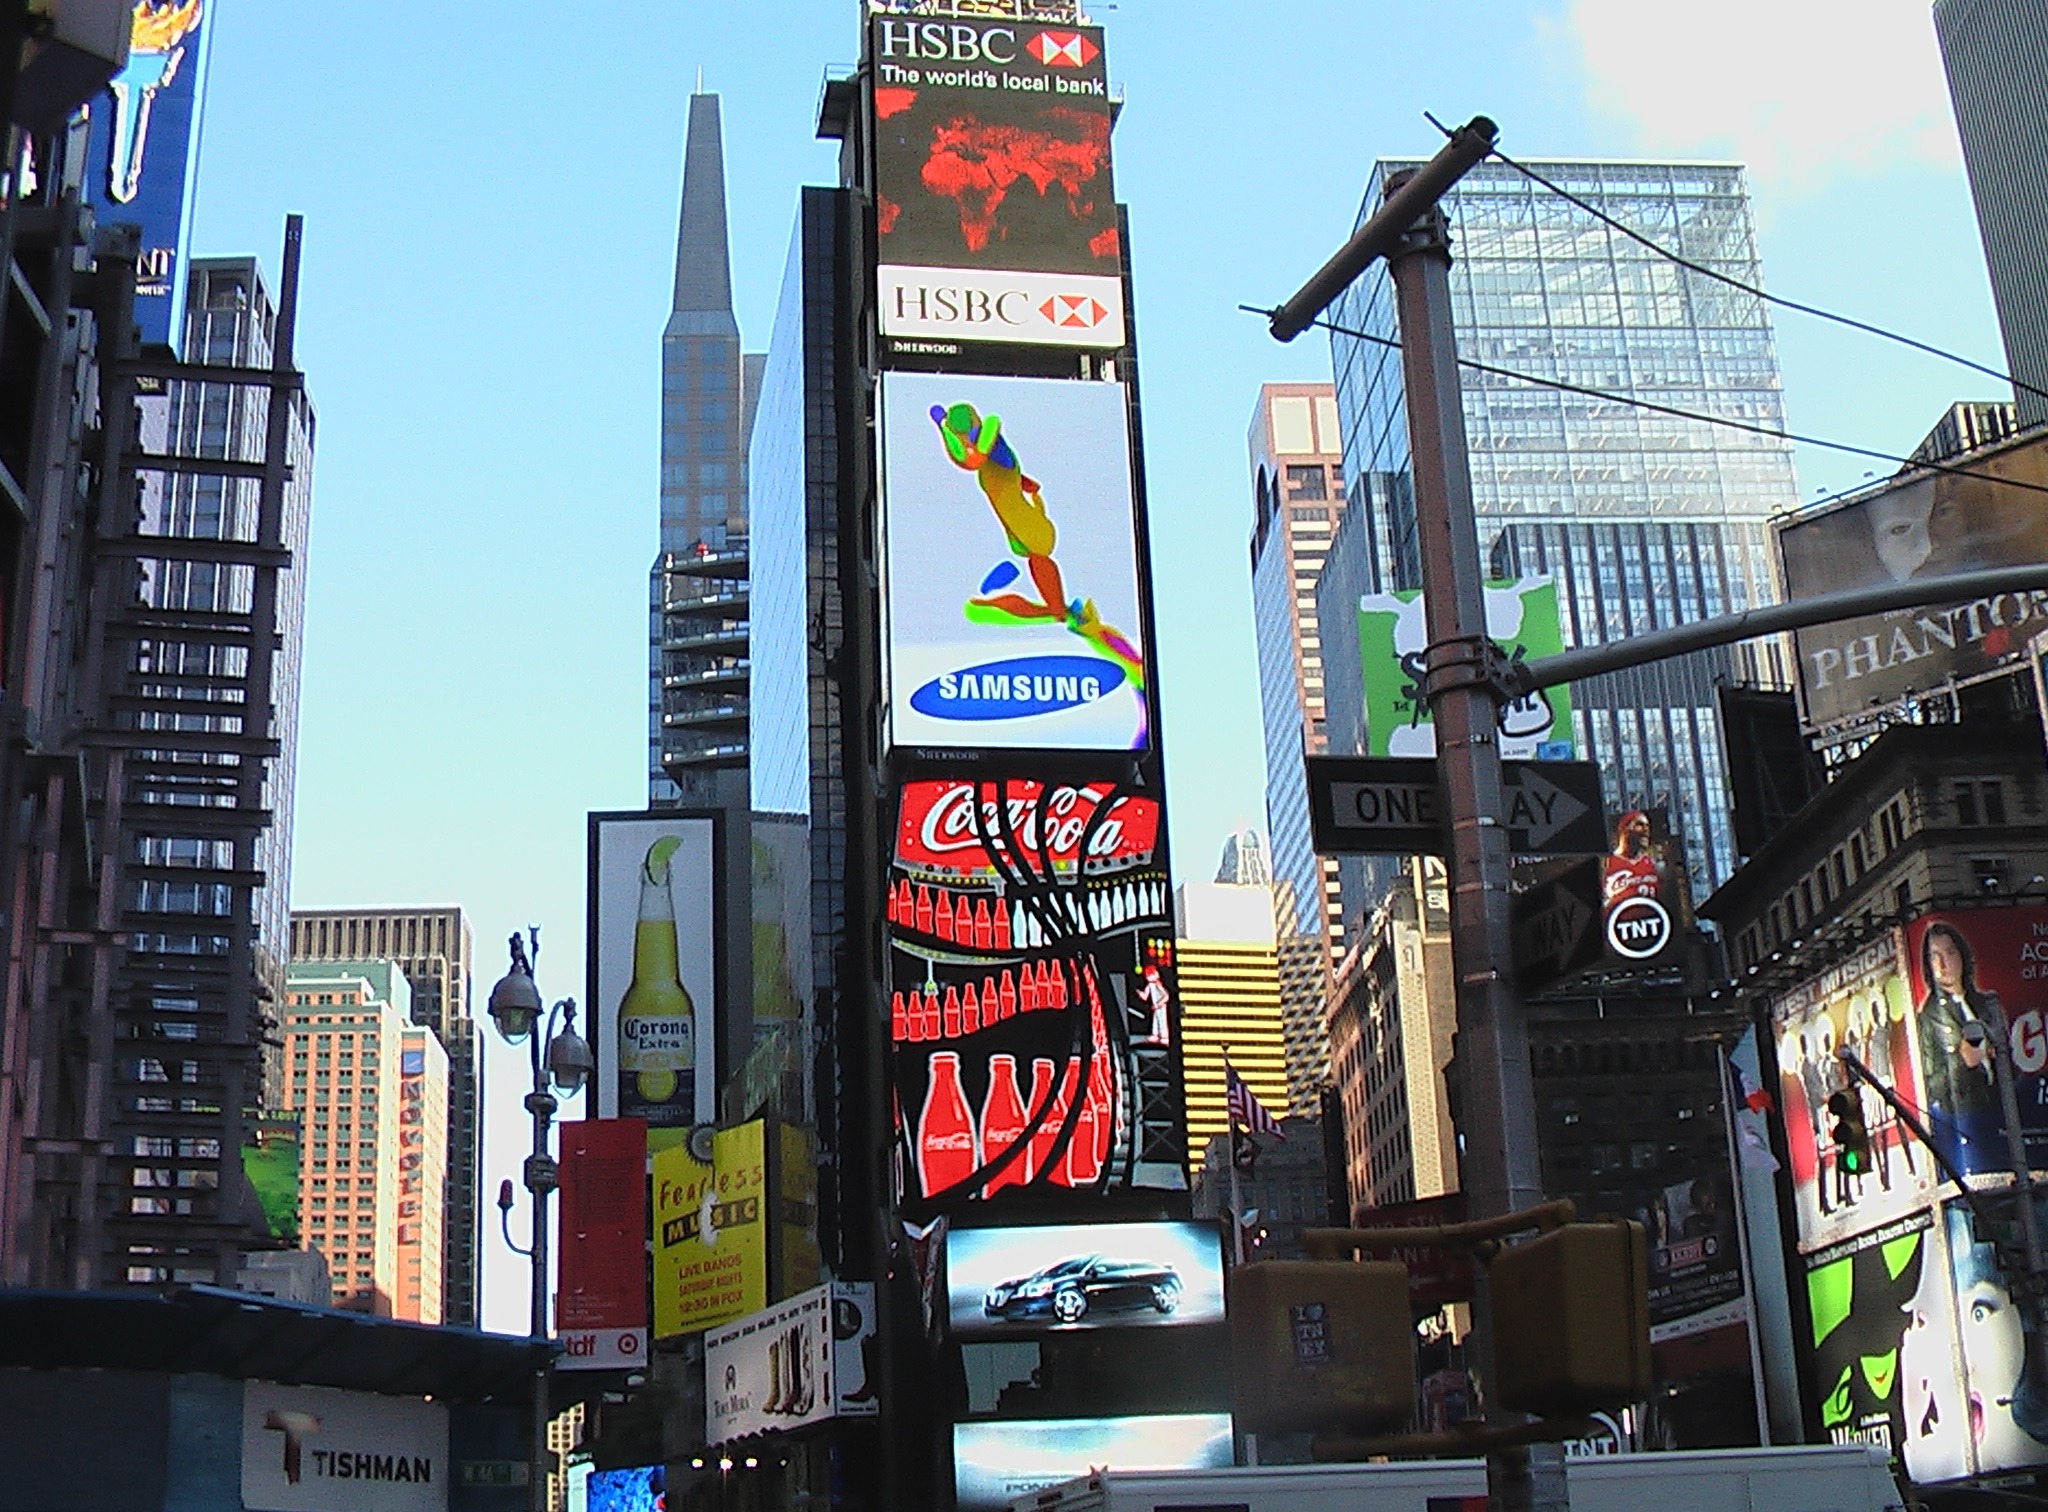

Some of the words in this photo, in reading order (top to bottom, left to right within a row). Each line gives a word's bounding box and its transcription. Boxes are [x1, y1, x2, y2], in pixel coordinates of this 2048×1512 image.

[881, 21, 1017, 64] HSBC
[881, 65, 920, 84] The
[926, 69, 997, 88] world's
[1003, 73, 1049, 92] local
[1056, 77, 1104, 96] bank
[895, 286, 1029, 326] HSBC
[939, 673, 1099, 702] SAMSUNG
[1355, 786, 1433, 824] ONE
[1617, 918, 1661, 941] TNT
[1821, 937, 1898, 999] MUSICAL
[625, 1018, 689, 1041] Corona
[639, 1038, 681, 1050] Extra
[566, 1334, 596, 1356] tdf
[1563, 1437, 1615, 1456] TNT
[312, 1450, 431, 1484] TISHMAN
